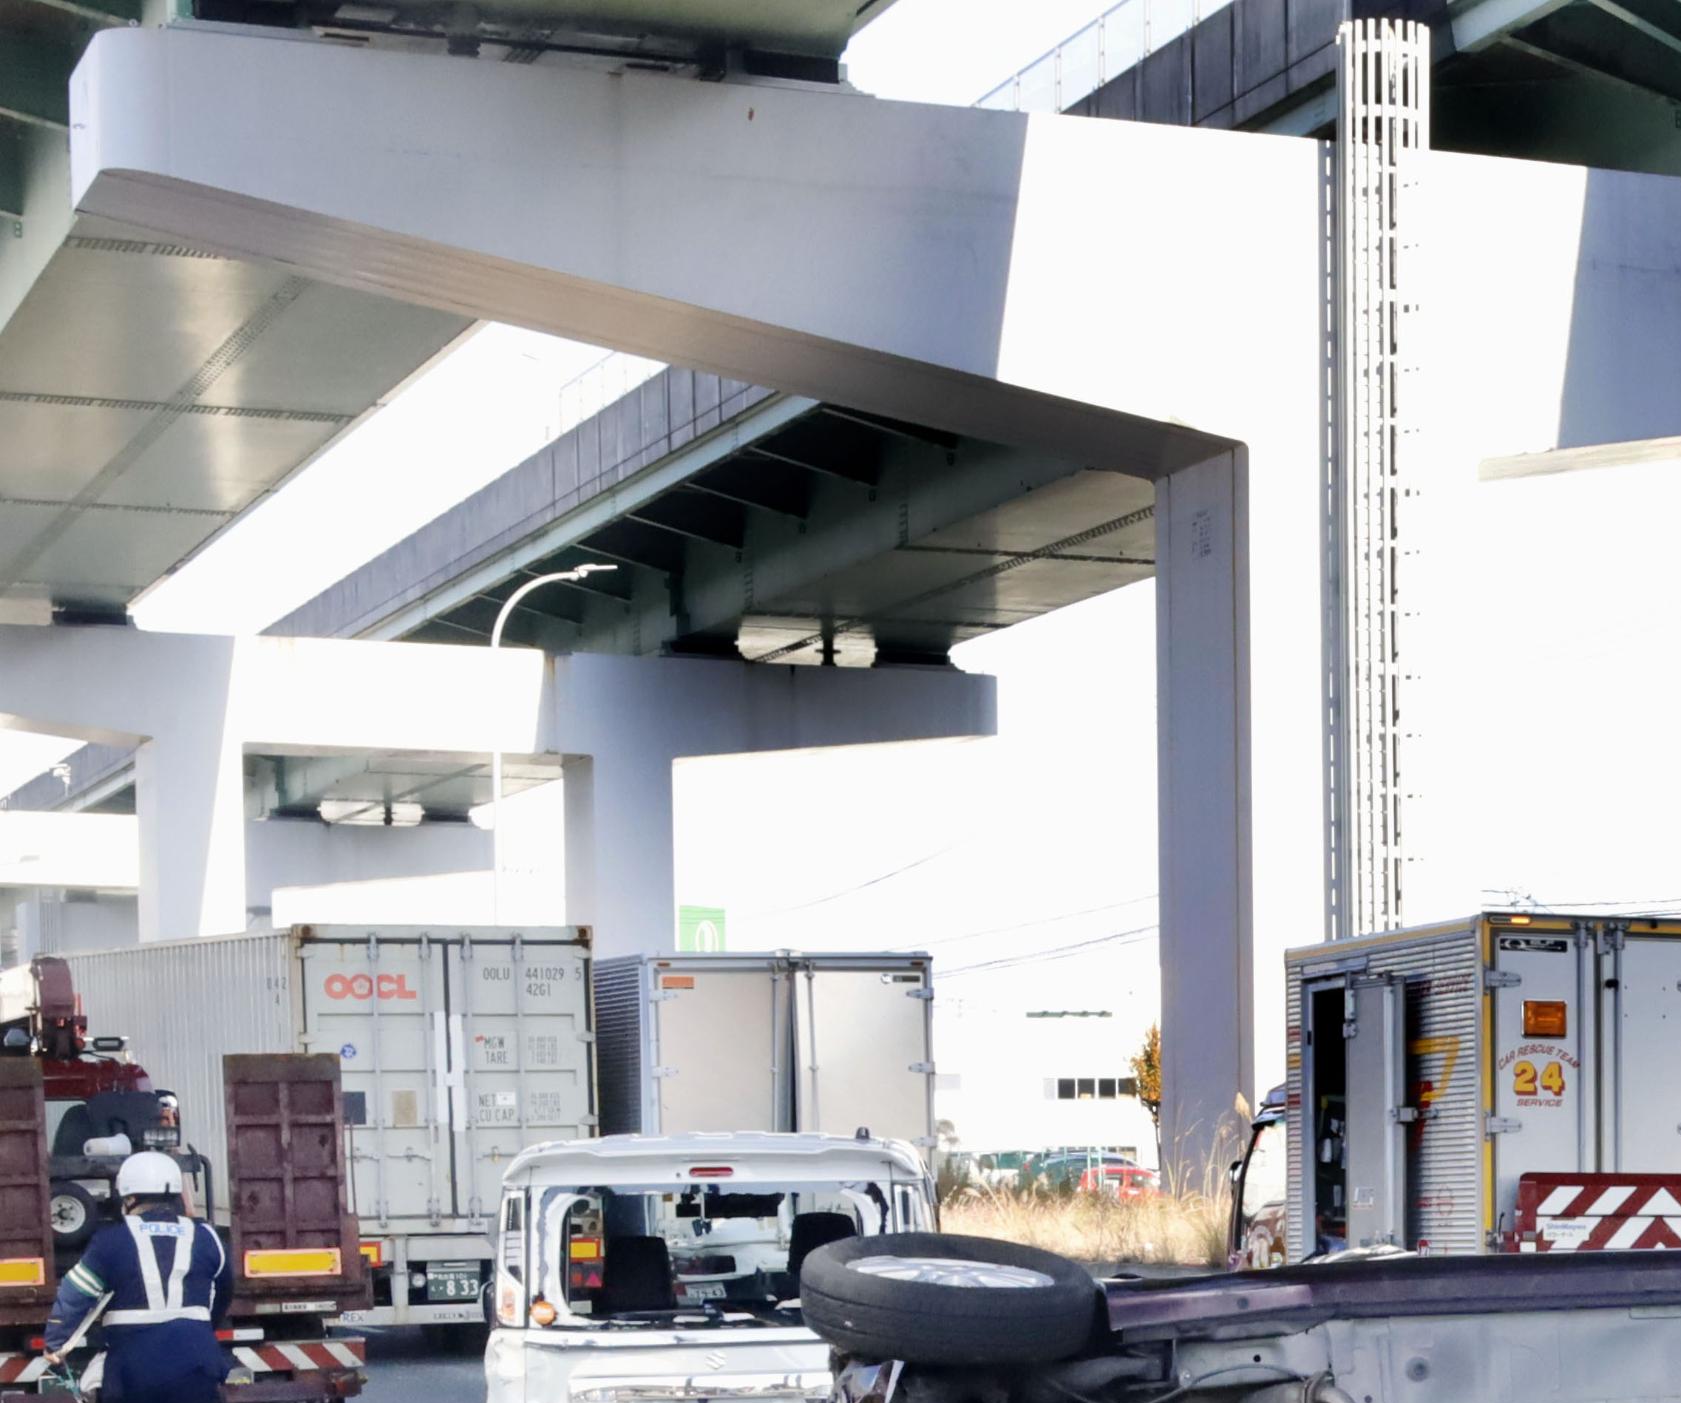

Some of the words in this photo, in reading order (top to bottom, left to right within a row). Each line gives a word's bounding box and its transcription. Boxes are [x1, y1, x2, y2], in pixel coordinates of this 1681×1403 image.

[525, 967, 565, 981] 441029
[575, 967, 582, 980] 5
[324, 973, 417, 1000] OOCL
[485, 1051, 508, 1064] TARE
[1498, 1050, 1516, 1070] CAR
[1513, 1060, 1565, 1096] 24
[479, 1094, 496, 1107] NET
[1517, 1098, 1563, 1107] SERVICE
[495, 1108, 514, 1121] CAP
[139, 1223, 186, 1236] POLICE
